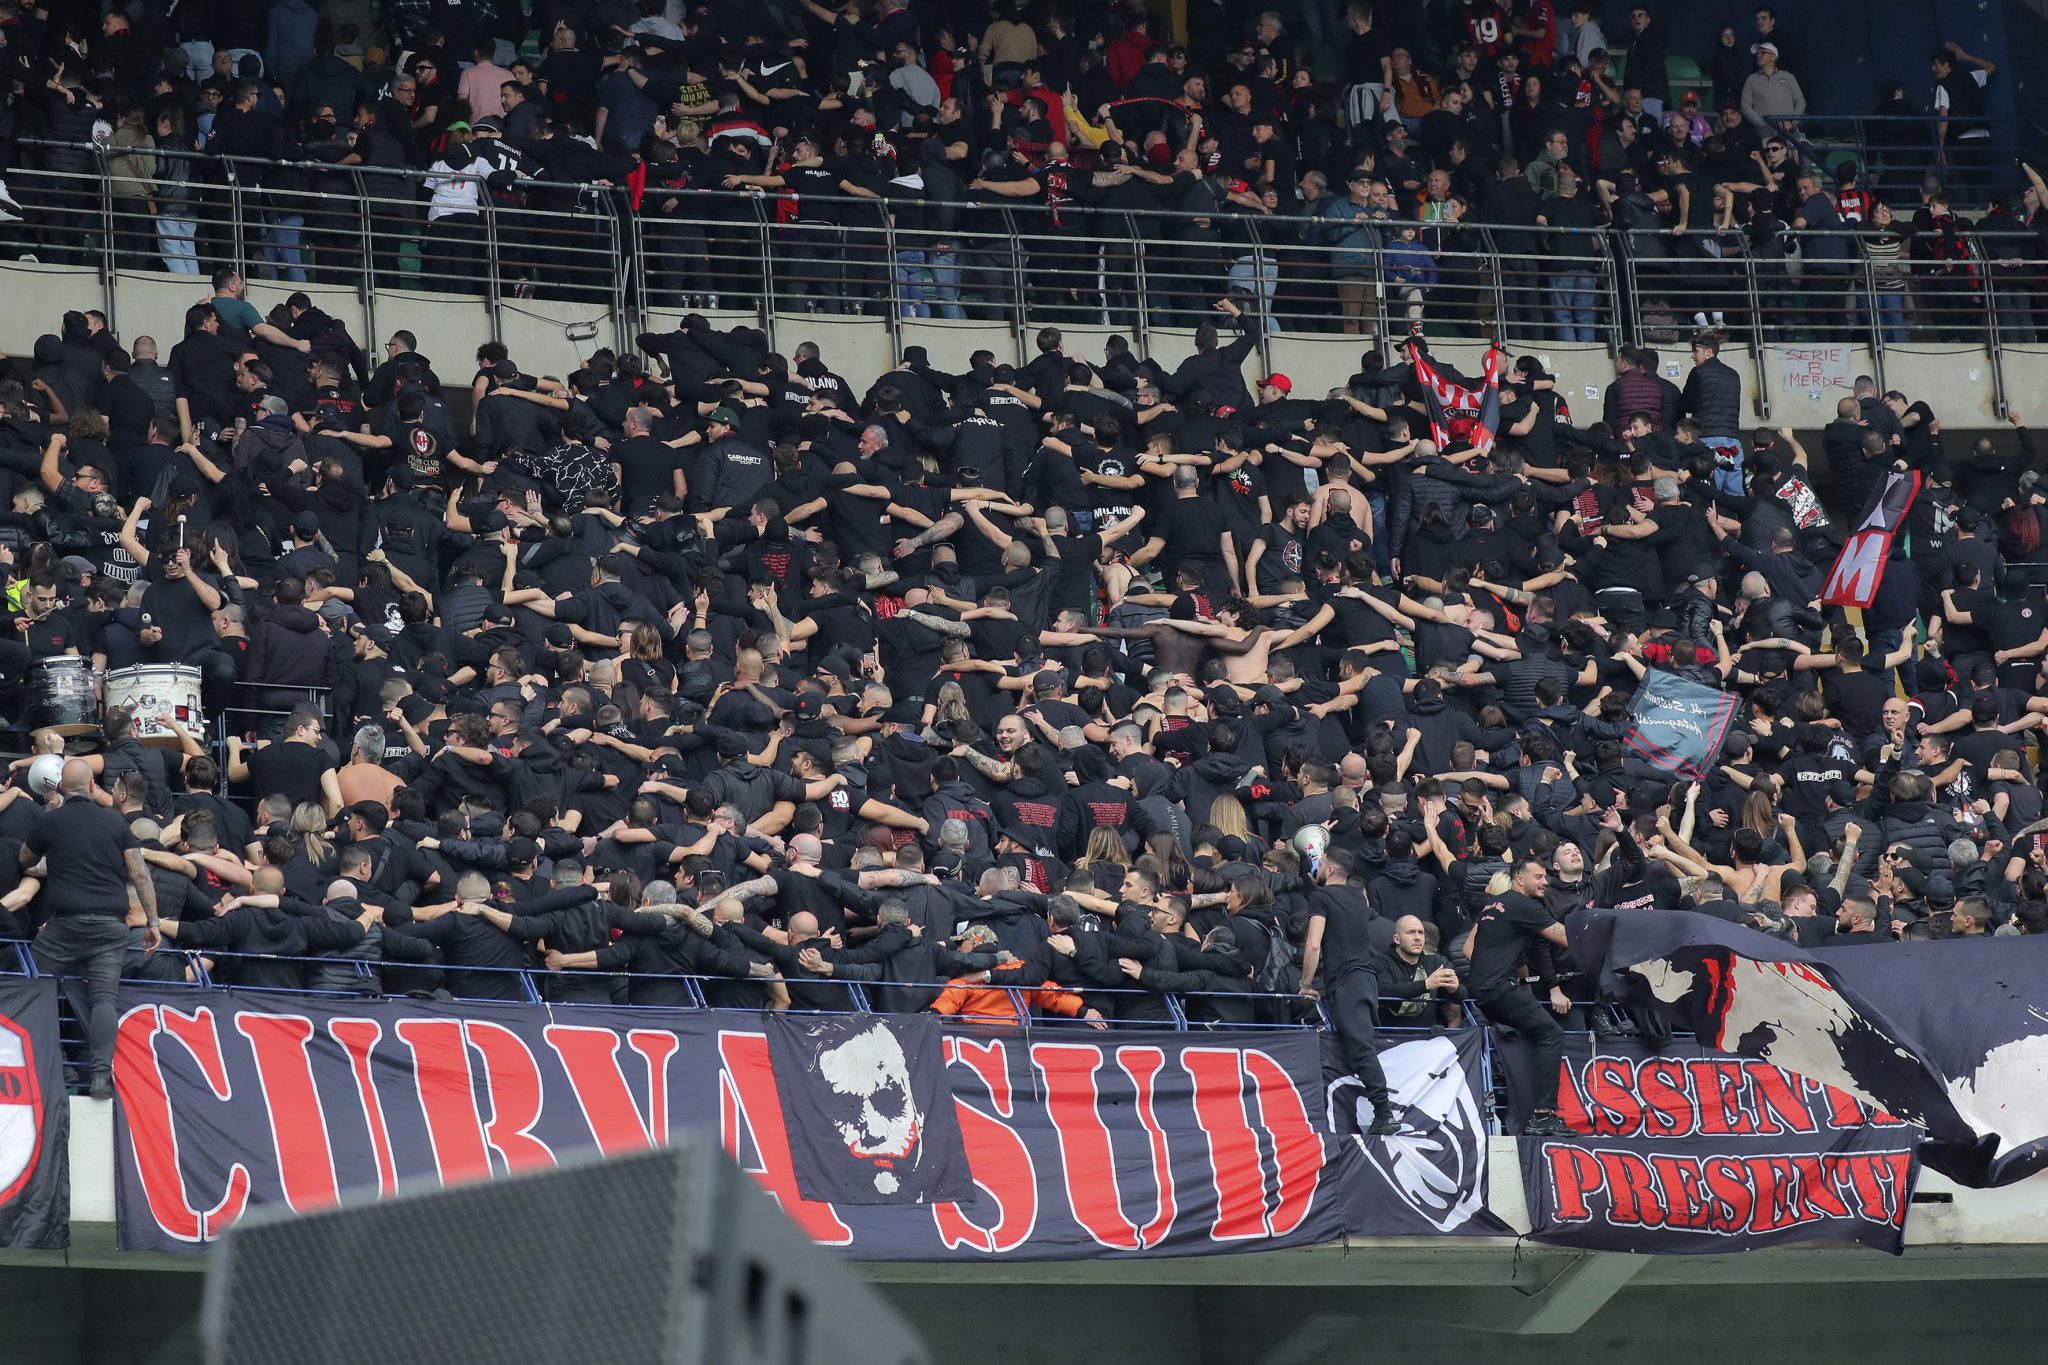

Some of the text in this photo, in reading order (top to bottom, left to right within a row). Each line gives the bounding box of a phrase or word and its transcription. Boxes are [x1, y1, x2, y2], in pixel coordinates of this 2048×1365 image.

[1471, 16, 1498, 48] 19
[1785, 349, 1843, 363] SERIE
[1809, 362, 1824, 376] B
[1789, 373, 1846, 388] MERDE
[831, 790, 849, 804] 50
[1556, 1054, 1912, 1139] ASSENT
[113, 1003, 1327, 1253] CURVA SUD
